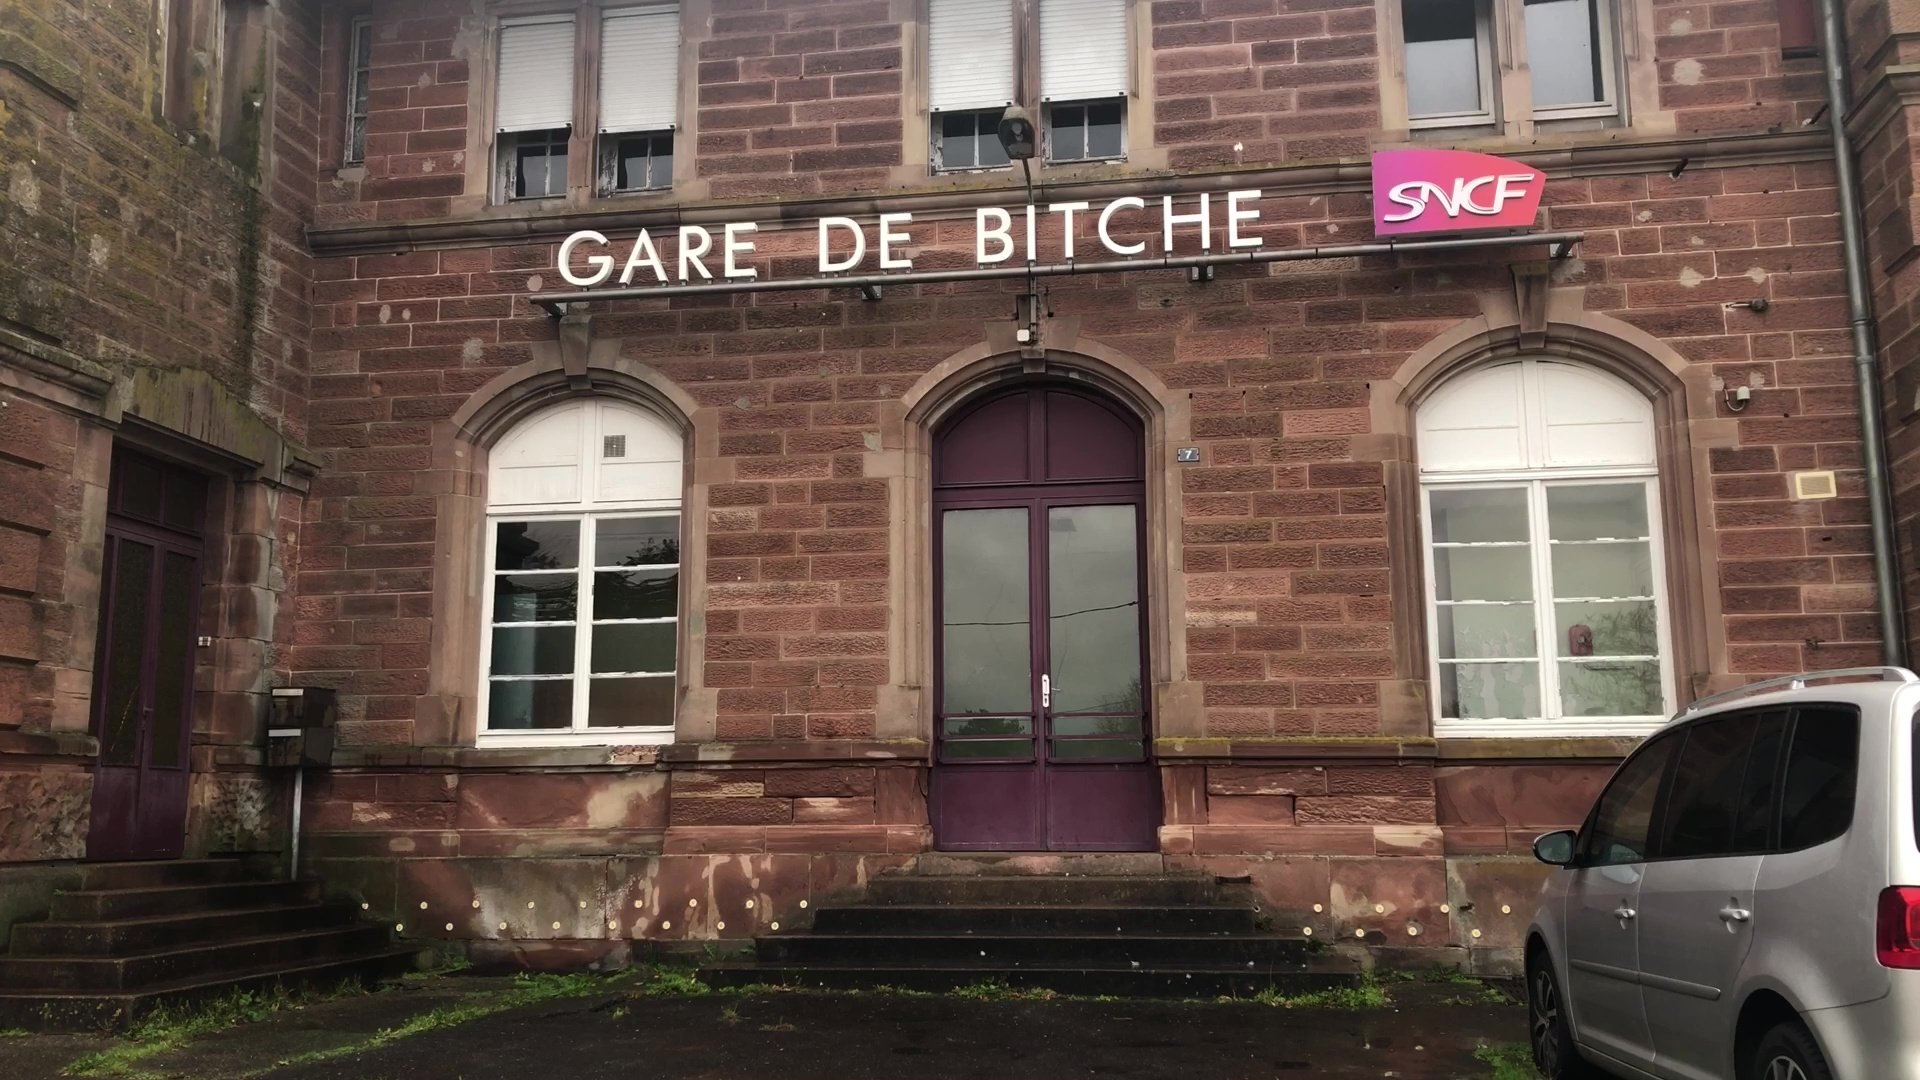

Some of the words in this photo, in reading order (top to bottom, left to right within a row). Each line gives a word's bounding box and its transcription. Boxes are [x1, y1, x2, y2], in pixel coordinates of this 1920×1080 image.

[1384, 173, 1535, 222] SNCF
[557, 221, 758, 287] GARE
[818, 213, 913, 273] DE
[976, 189, 1263, 264] BITCHE
[1185, 450, 1192, 460] 7
